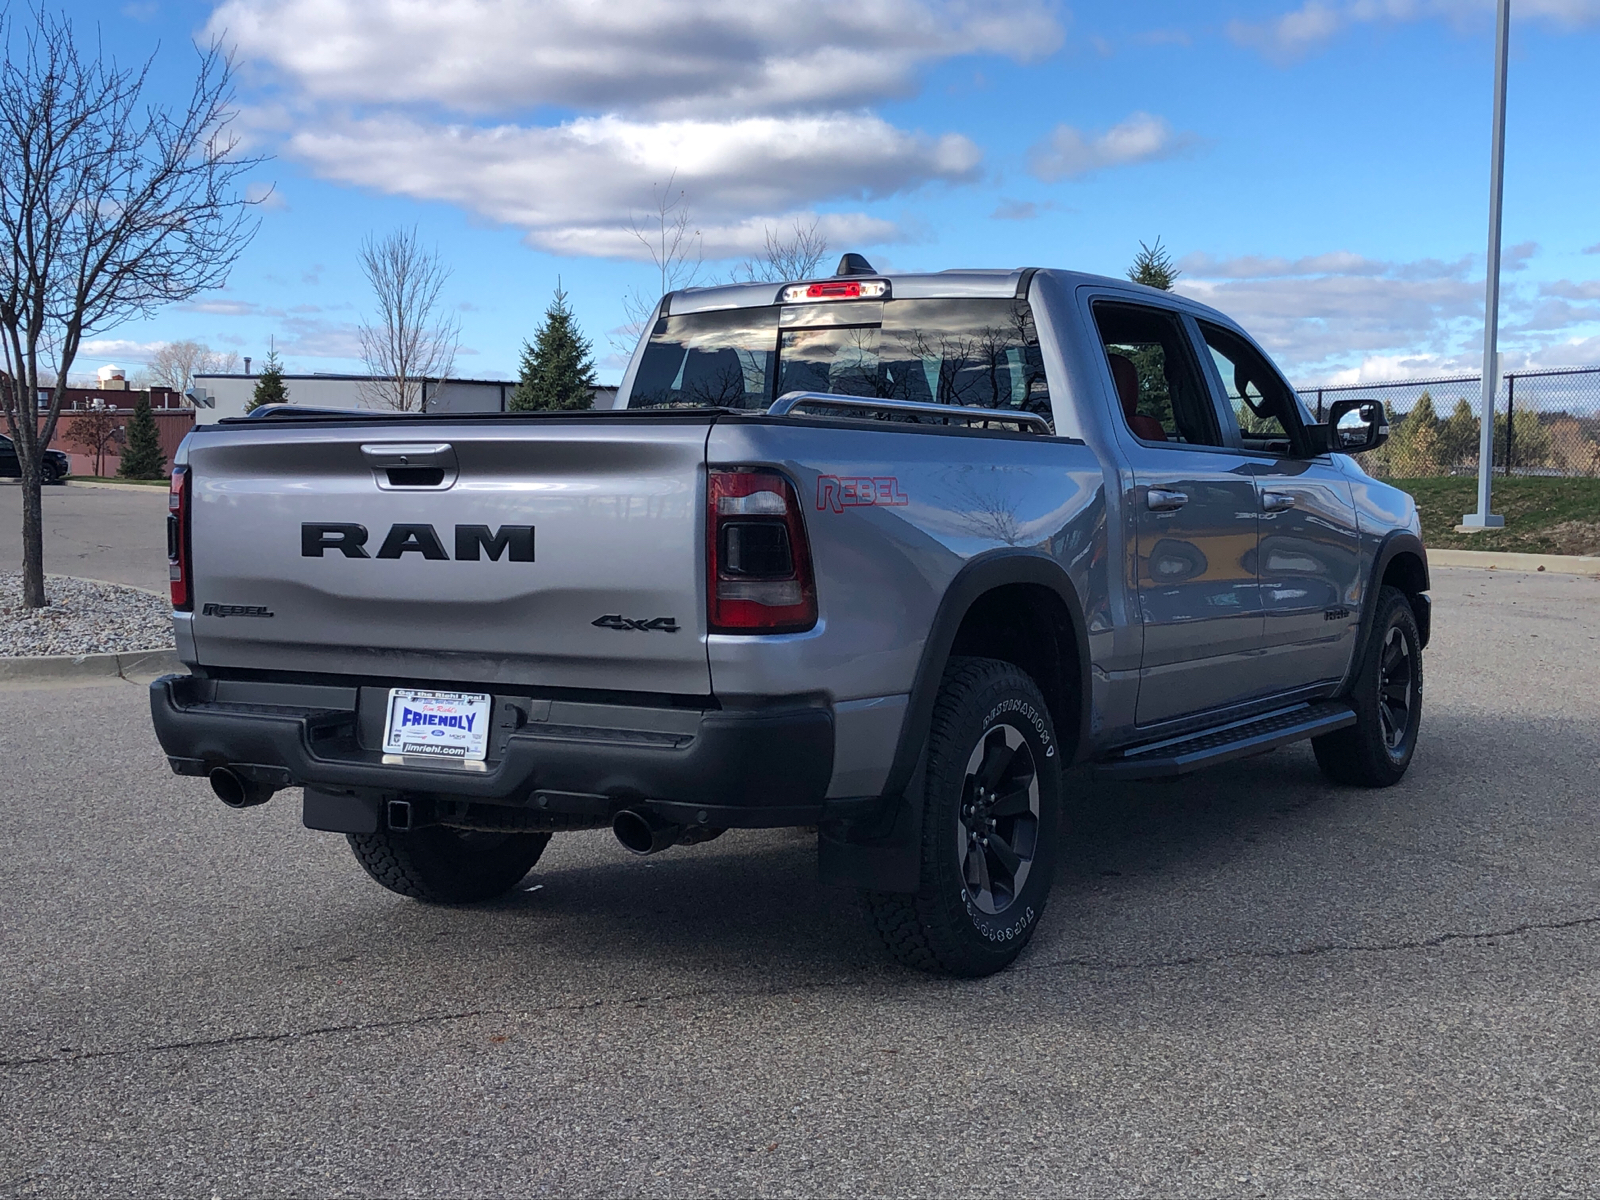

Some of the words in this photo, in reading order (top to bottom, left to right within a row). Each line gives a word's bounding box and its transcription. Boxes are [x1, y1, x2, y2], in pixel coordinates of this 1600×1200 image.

[816, 474, 909, 514] REBEL
[301, 522, 536, 563] RAM
[202, 603, 275, 618] REBEL
[591, 614, 681, 633] 4x4
[402, 707, 476, 733] FRIENDLY
[982, 698, 1050, 745] DESTINATION
[404, 743, 464, 755] jimriehl.com
